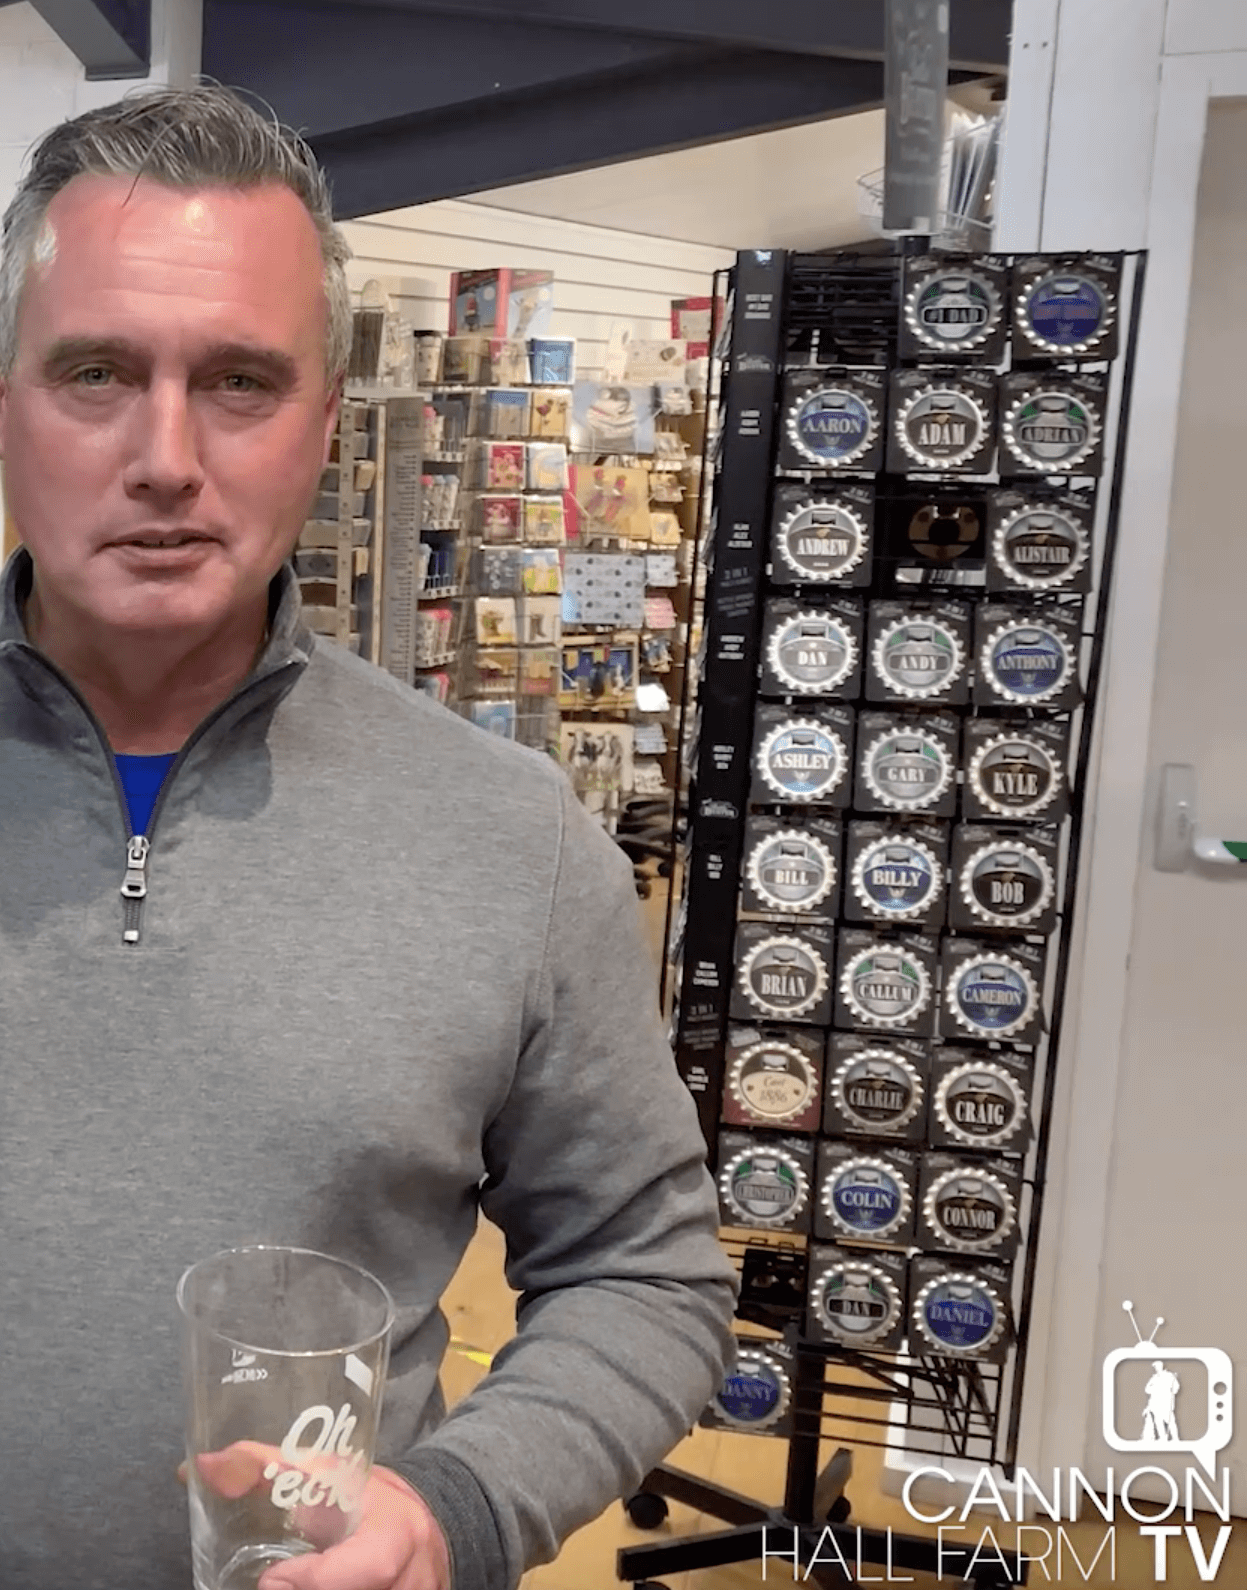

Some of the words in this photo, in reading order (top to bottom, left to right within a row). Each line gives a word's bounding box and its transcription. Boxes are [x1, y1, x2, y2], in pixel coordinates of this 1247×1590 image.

[803, 417, 862, 434] AARON
[917, 422, 966, 446] ADAM
[1023, 426, 1081, 443] ADRIAN
[796, 538, 850, 557] ANDREW
[1013, 546, 1071, 564] ALISTAIR
[797, 650, 828, 667] DAN
[898, 654, 939, 671] ANDY
[997, 655, 1059, 671] ANTHONY
[772, 752, 832, 770] ASHLEY
[887, 767, 929, 783] GARY
[993, 772, 1038, 796] KYLE
[774, 869, 809, 885] BILL
[871, 869, 923, 887] BILLY
[991, 881, 1025, 904] BOB
[760, 973, 807, 997] BRIAN
[859, 984, 913, 1001] CALLUM
[961, 987, 1022, 1006] CAMERON
[849, 1087, 903, 1110] CHARLIE
[955, 1101, 1005, 1125] CRAIG
[841, 1190, 893, 1209] COLIN
[942, 1207, 996, 1230] CONNOR
[841, 1300, 871, 1316] DAN
[929, 1305, 990, 1327] DANIEL
[280, 1402, 357, 1464] Oh
